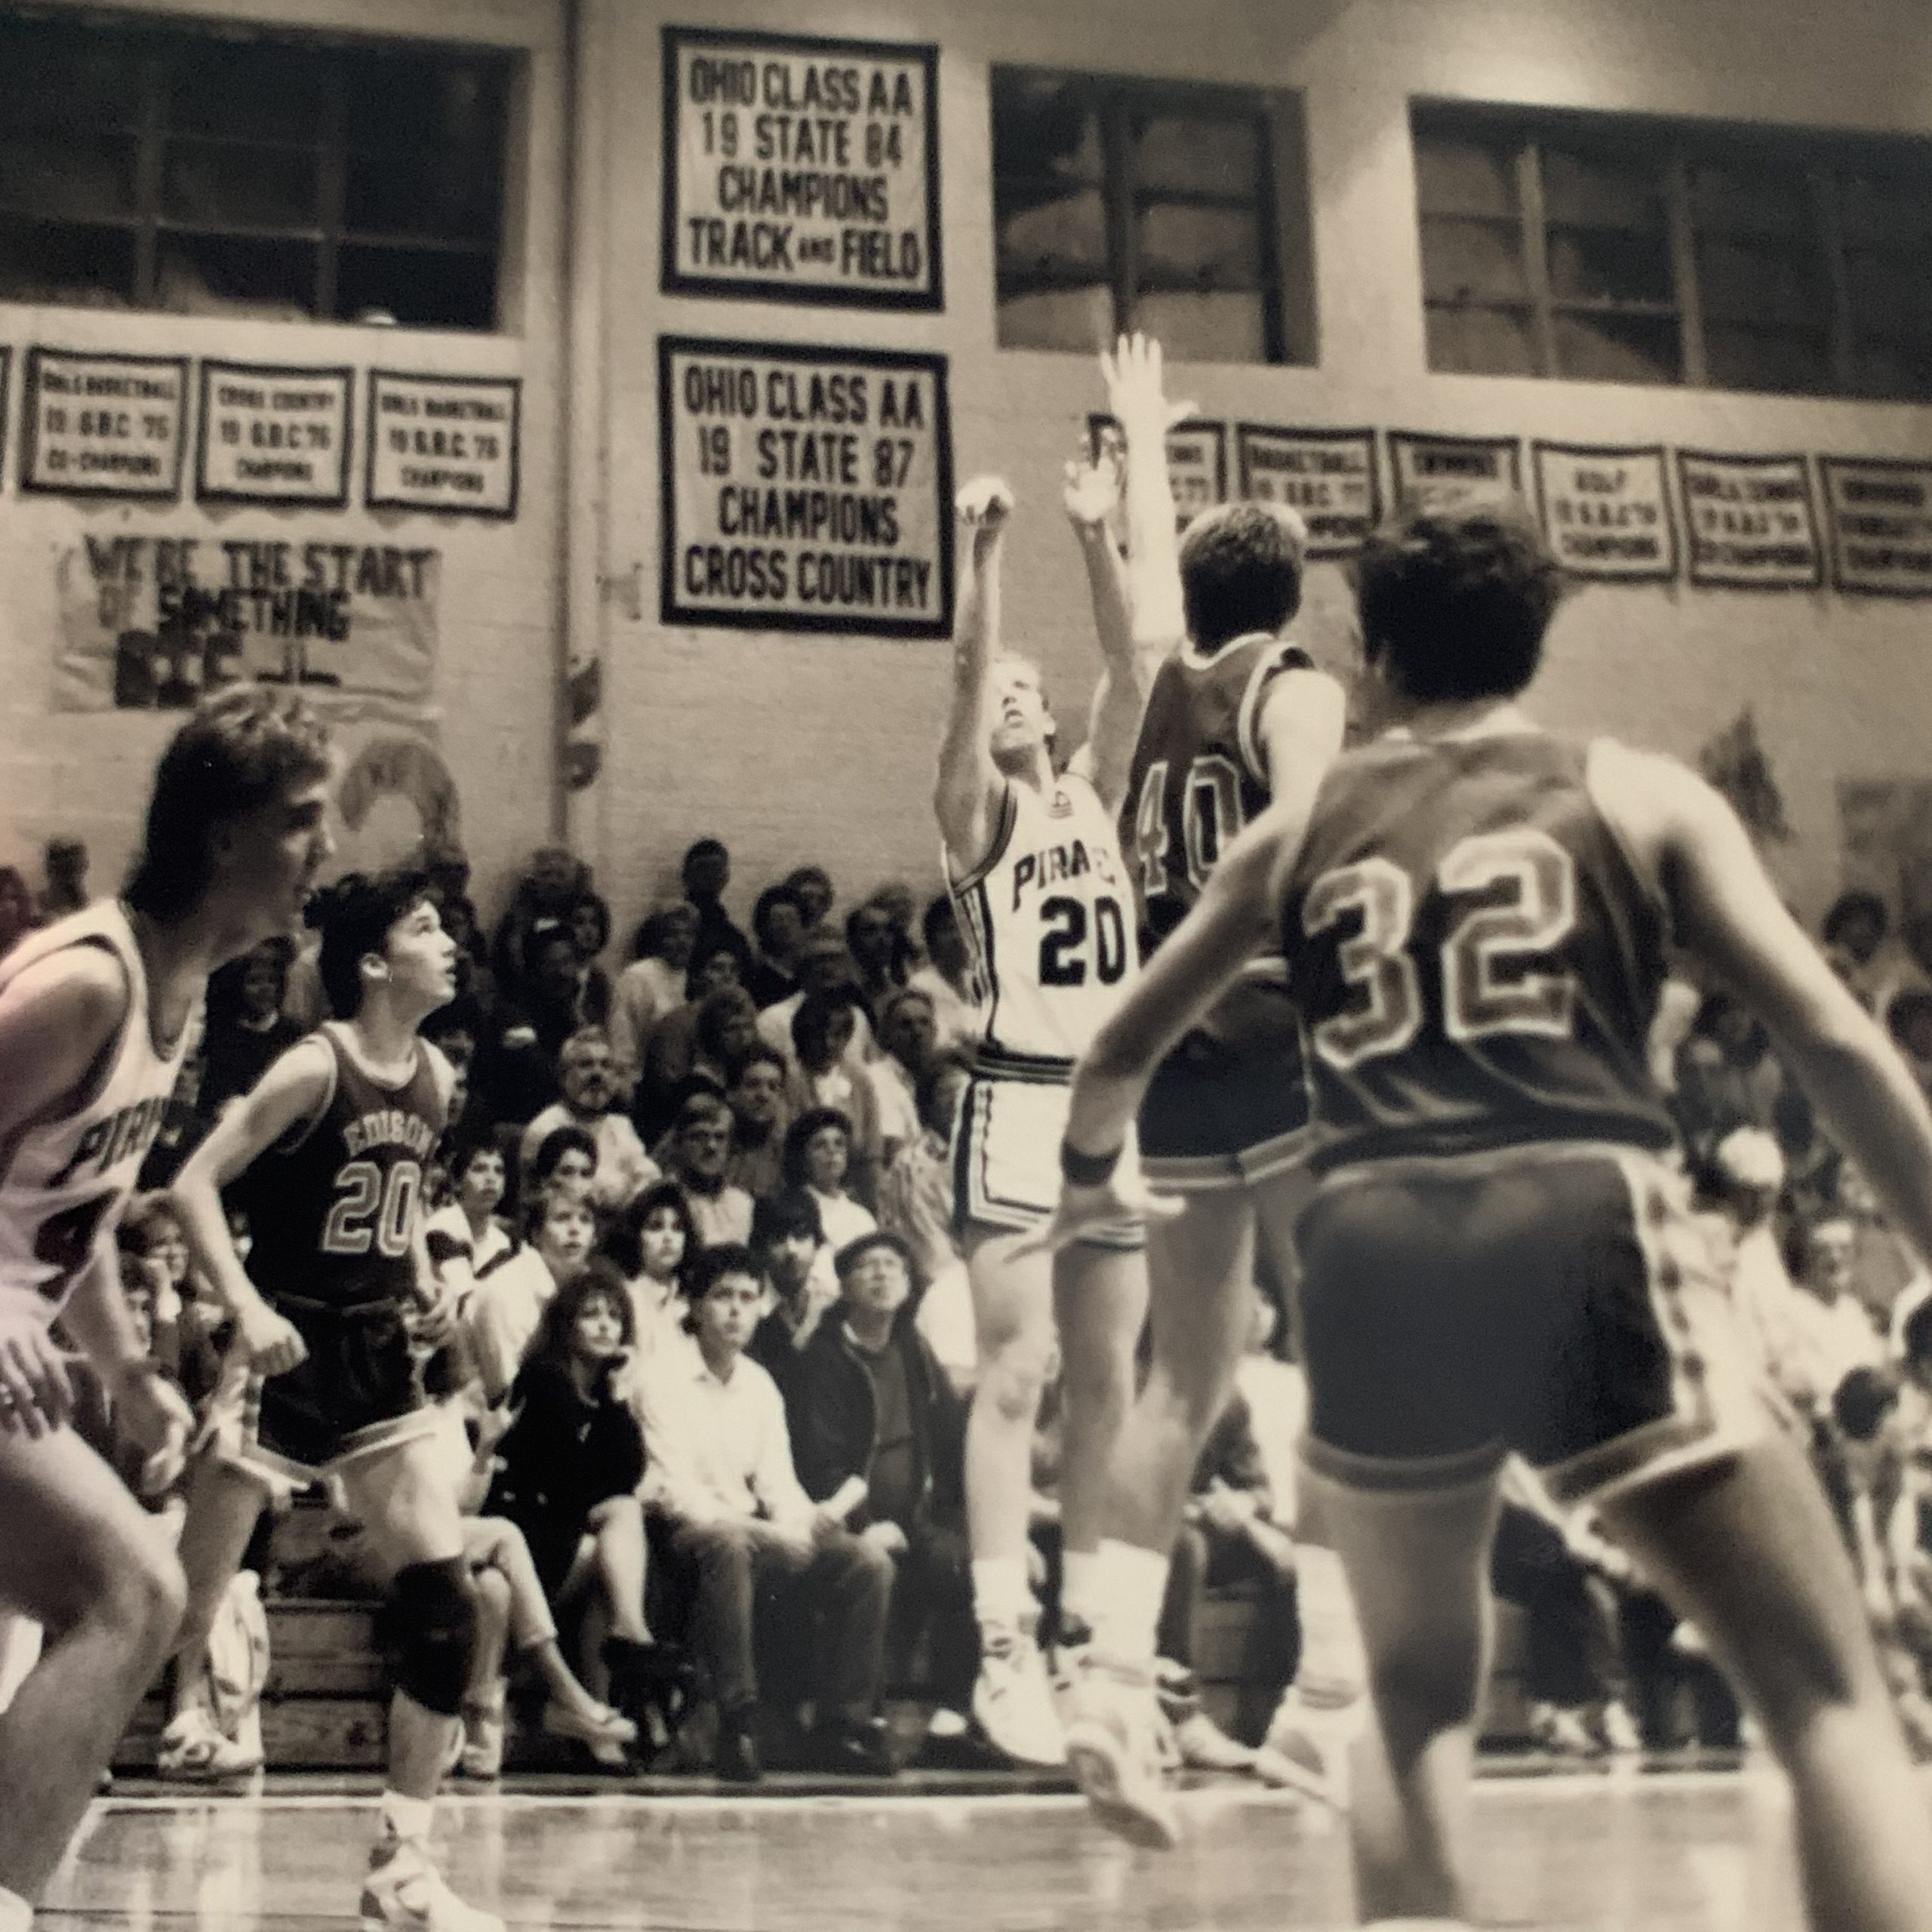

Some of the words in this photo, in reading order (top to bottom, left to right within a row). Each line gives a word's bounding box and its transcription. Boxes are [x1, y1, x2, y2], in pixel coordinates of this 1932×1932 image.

[690, 58, 755, 106] OHIO
[763, 62, 860, 114] CLASS
[702, 110, 739, 159] 19
[755, 114, 851, 168] STATE
[719, 164, 889, 223] CHAMPIONS
[688, 216, 795, 272] TRACK
[841, 228, 920, 279] FIELD
[685, 365, 758, 419] OHIO
[767, 371, 868, 425] CLASS
[880, 379, 924, 430] AA
[699, 424, 731, 476] 19
[758, 428, 859, 485] STATE
[874, 438, 916, 488] 87
[719, 485, 899, 546] CHAMPIONS
[222, 539, 291, 586] THE
[303, 543, 441, 598] START
[685, 545, 787, 600] CROSS
[797, 550, 931, 609] COUNTRY
[1135, 755, 1246, 897] 40
[1038, 895, 1127, 986] 20
[1303, 828, 1577, 1070] 32
[323, 1161, 422, 1257] 20
